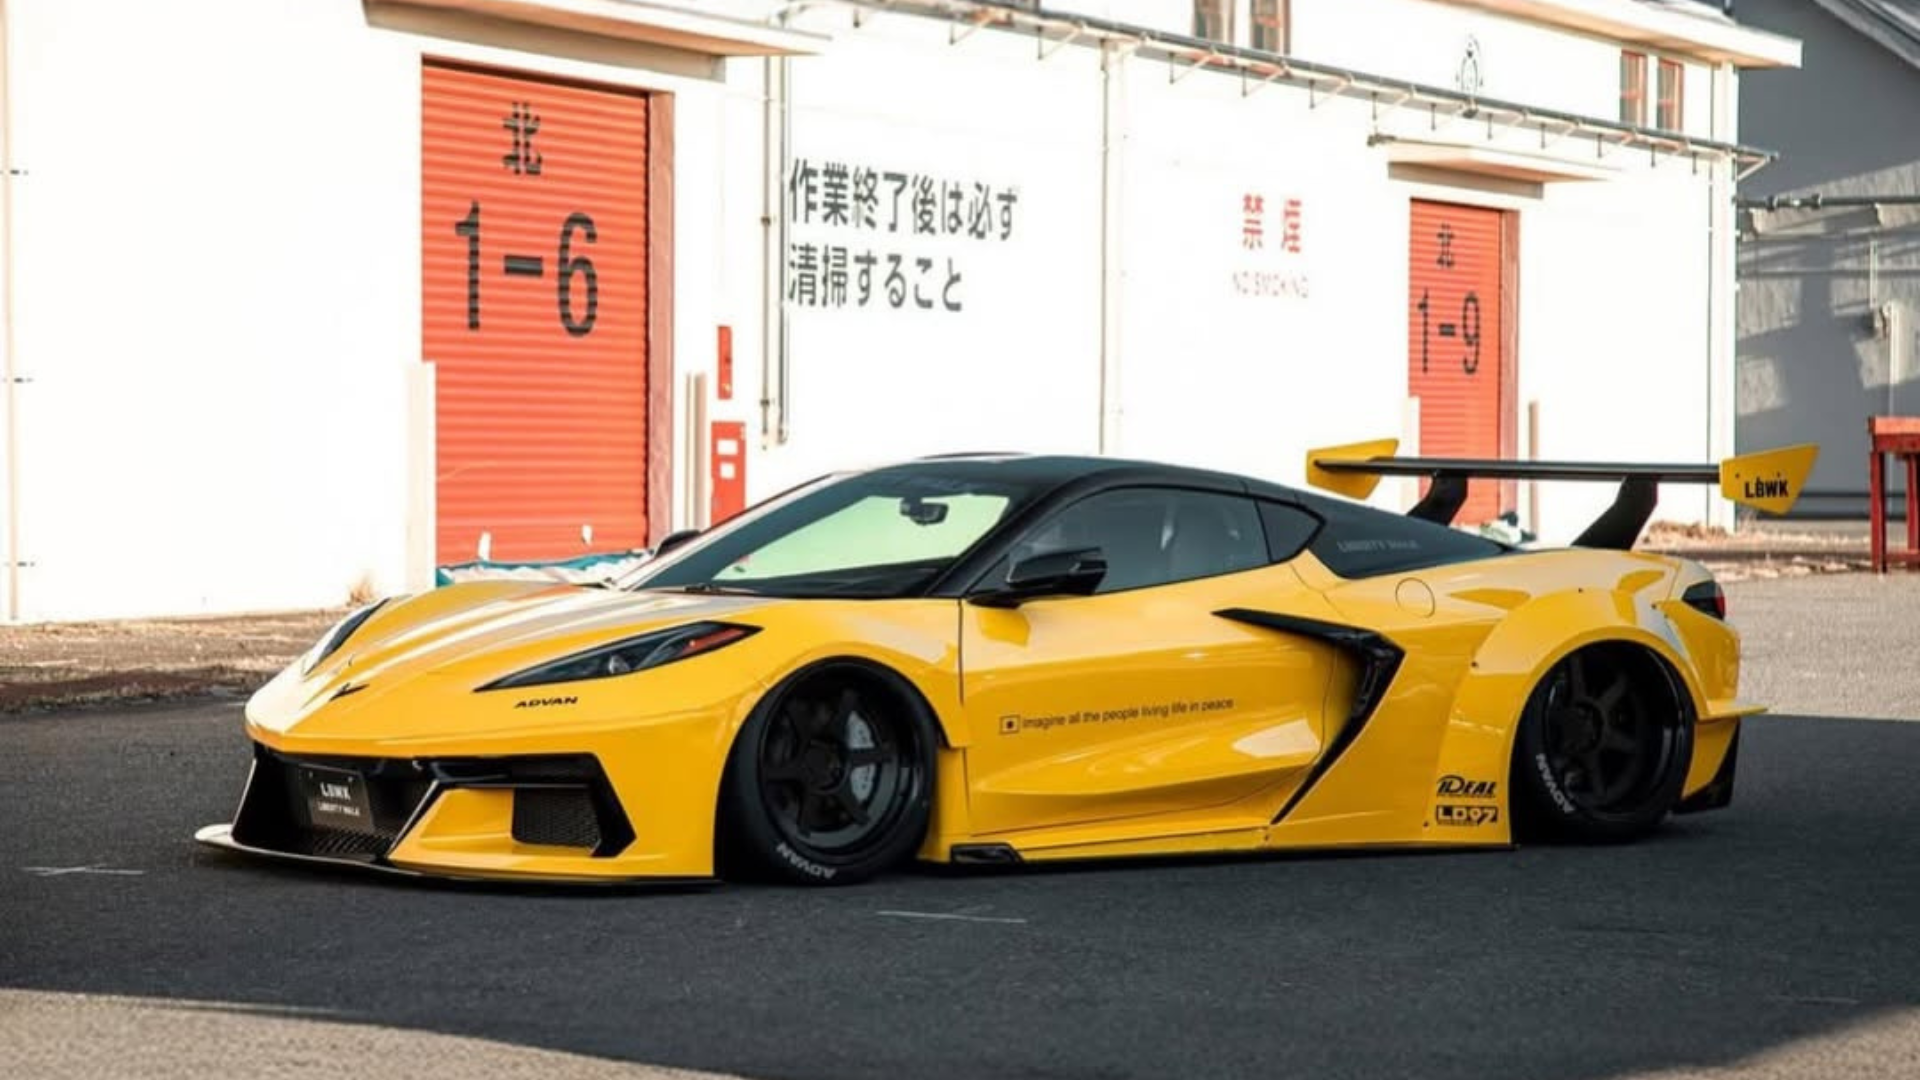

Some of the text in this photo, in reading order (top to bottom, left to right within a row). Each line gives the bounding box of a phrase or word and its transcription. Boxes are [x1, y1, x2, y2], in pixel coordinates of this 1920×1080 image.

[503, 102, 543, 175] 北
[789, 158, 1019, 241] 作業終了後は必ず
[455, 200, 598, 338] 1-6
[1436, 223, 1455, 268] 北
[788, 243, 963, 312] 清掃すること
[1417, 287, 1480, 375] 1-9
[1744, 478, 1789, 499] LBWK
[514, 697, 578, 709] ADVAN
[1083, 710, 1100, 722] the
[1102, 709, 1139, 722] people
[1190, 702, 1199, 712] in
[1201, 699, 1234, 712] peace
[776, 842, 836, 879] ADVAN
